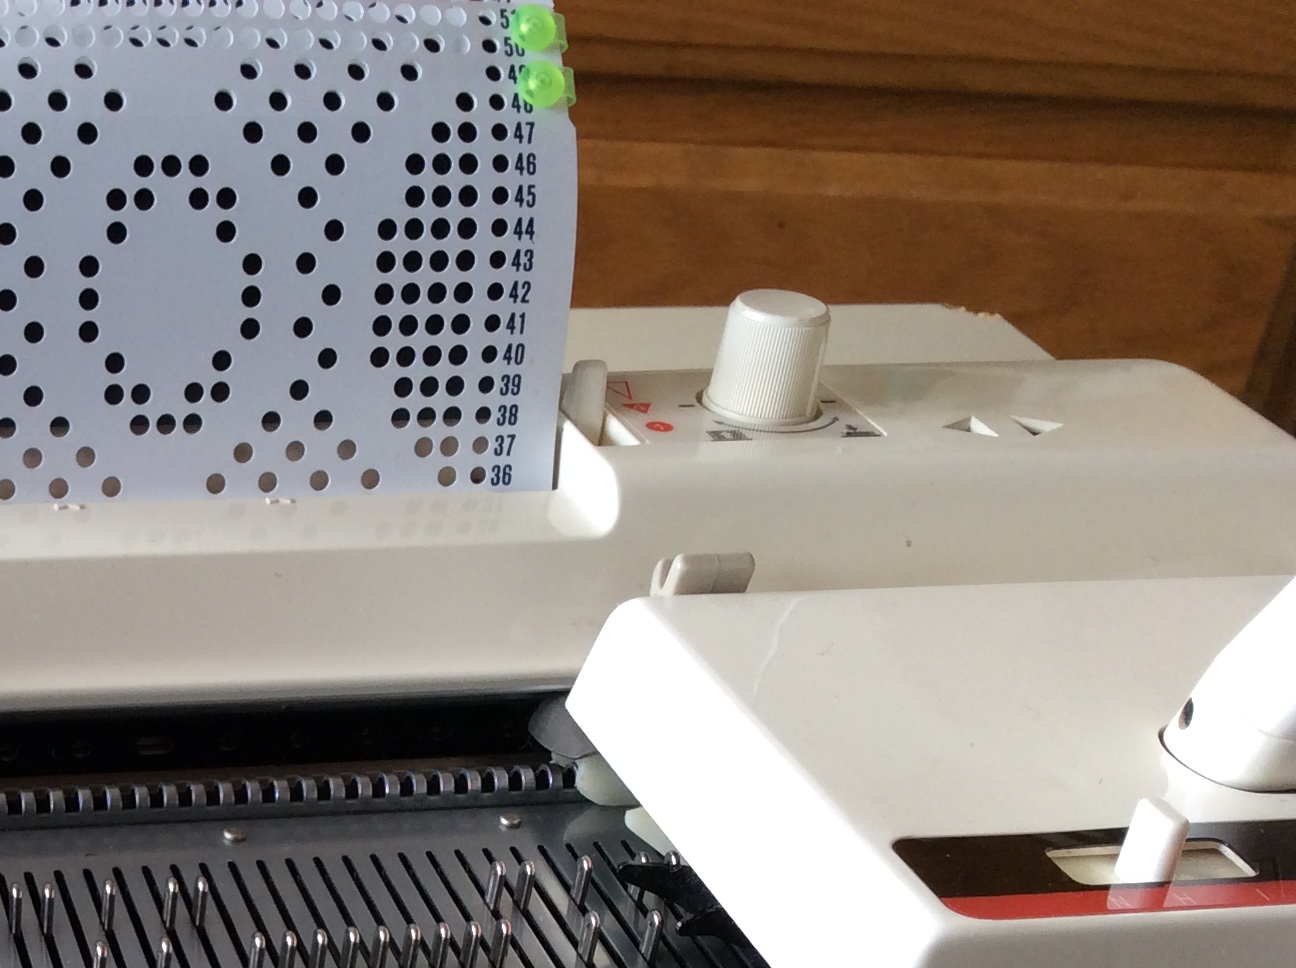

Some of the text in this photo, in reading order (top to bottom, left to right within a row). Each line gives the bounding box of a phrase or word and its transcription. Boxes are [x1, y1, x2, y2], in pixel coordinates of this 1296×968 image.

[508, 64, 526, 84] 4
[514, 122, 535, 144] 47
[515, 153, 537, 176] 46
[514, 185, 537, 208] 45
[513, 217, 535, 241] 44
[511, 249, 534, 272] 43
[509, 280, 532, 304] 42
[506, 312, 526, 335] 41
[503, 343, 526, 365] 40
[499, 374, 522, 396] 39
[496, 404, 519, 426] 38
[493, 434, 516, 457] 37
[490, 464, 512, 486] 36
